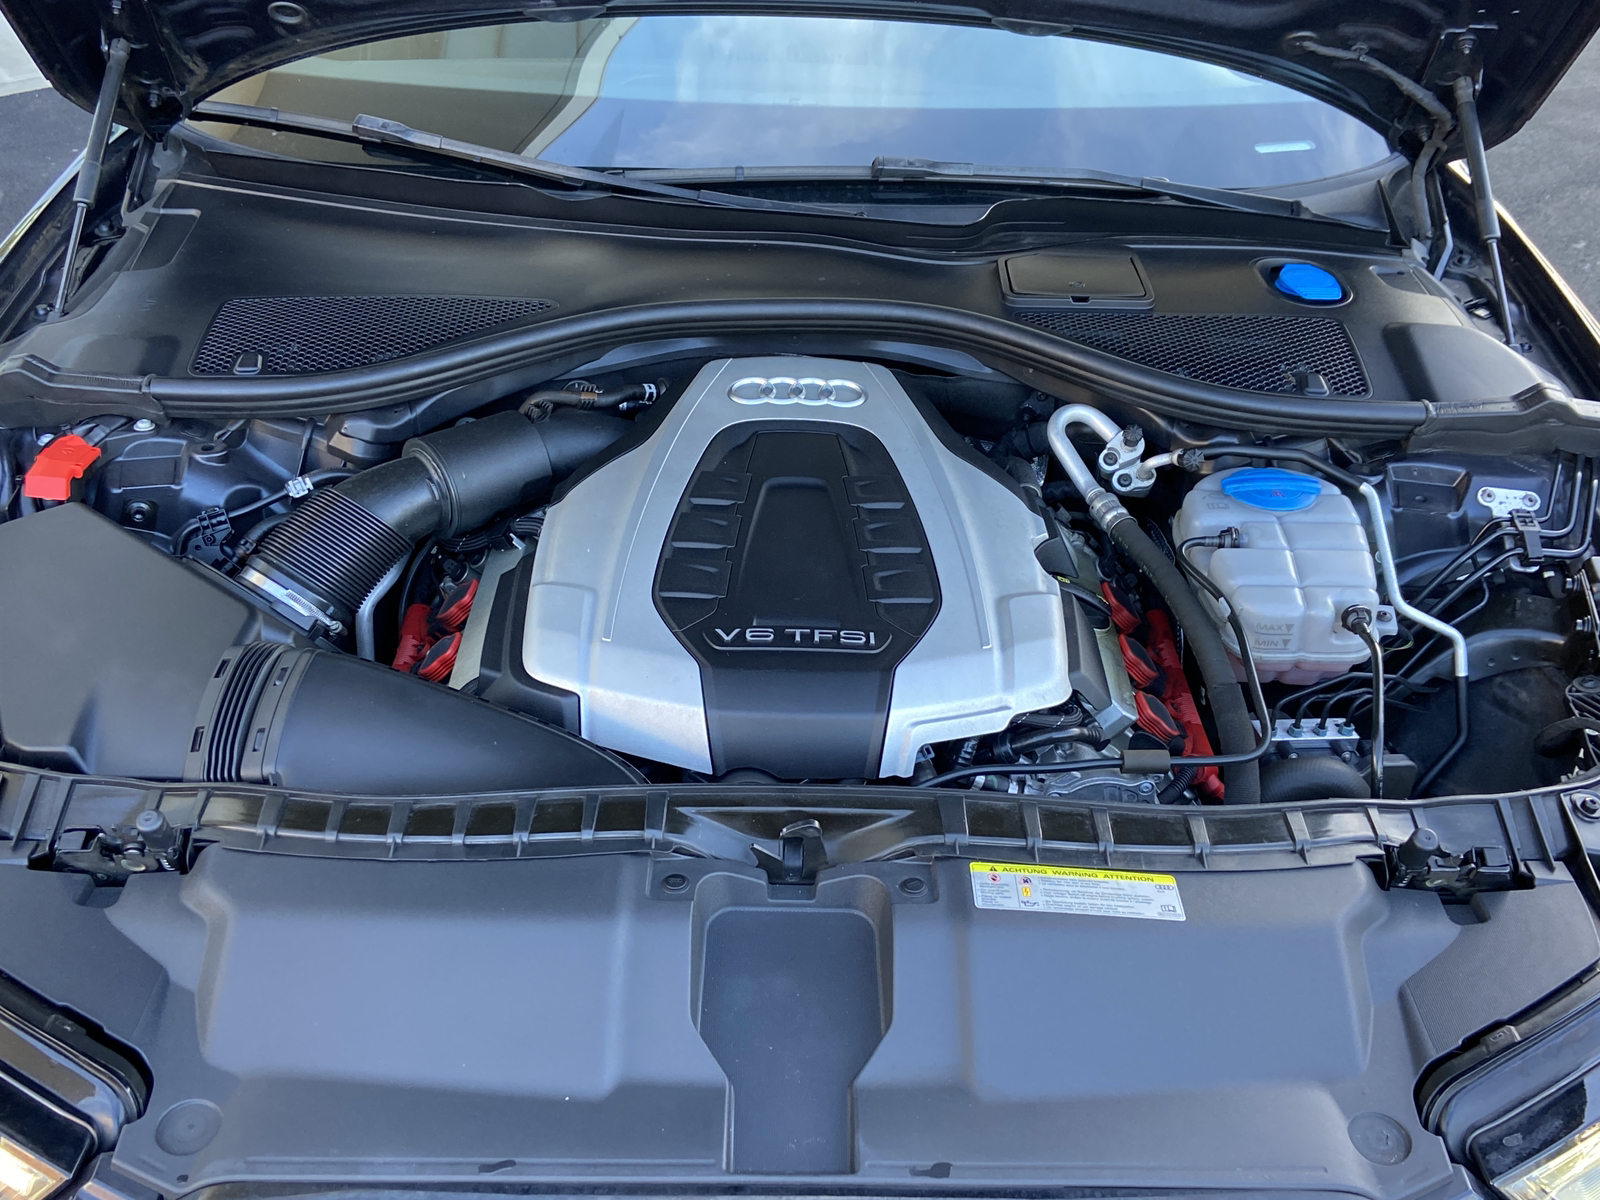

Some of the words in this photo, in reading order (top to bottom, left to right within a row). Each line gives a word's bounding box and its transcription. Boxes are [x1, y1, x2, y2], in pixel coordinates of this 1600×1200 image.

[1256, 623, 1283, 631] MAX
[714, 627, 775, 643] V6
[784, 628, 876, 646] TFSI
[1254, 639, 1278, 647] MIN
[1002, 866, 1047, 875] ACHTUNG
[1052, 870, 1098, 878] WARNING
[1103, 873, 1154, 882] ATTENTION
